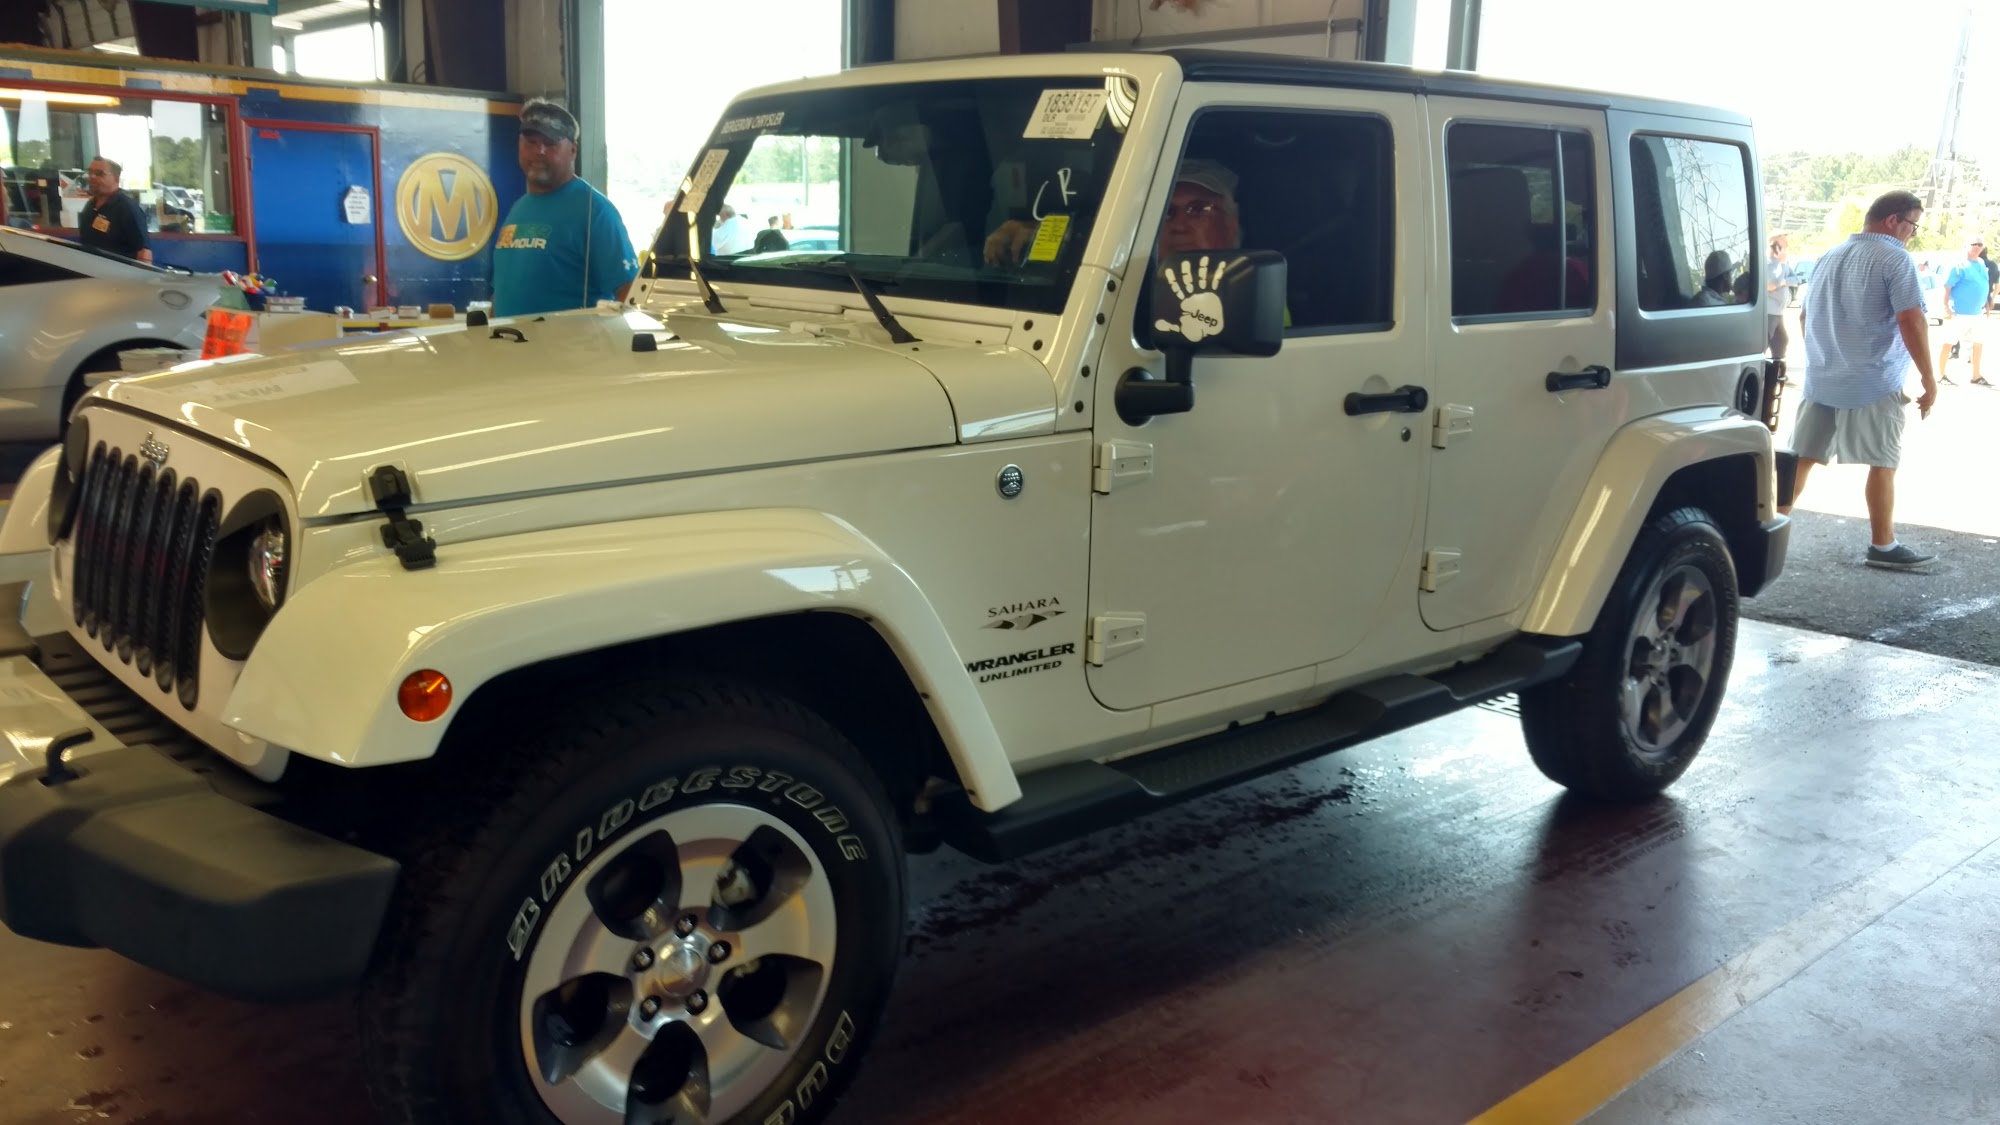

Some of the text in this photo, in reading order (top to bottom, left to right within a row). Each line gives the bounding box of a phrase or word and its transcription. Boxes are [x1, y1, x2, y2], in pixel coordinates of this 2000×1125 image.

[1190, 309, 1218, 328] Jeep
[987, 596, 1061, 618] SAHARA
[966, 642, 1076, 673] WRANGLER
[979, 660, 1063, 684] UNLIMITED
[505, 765, 869, 962] BRIDGESTONE
